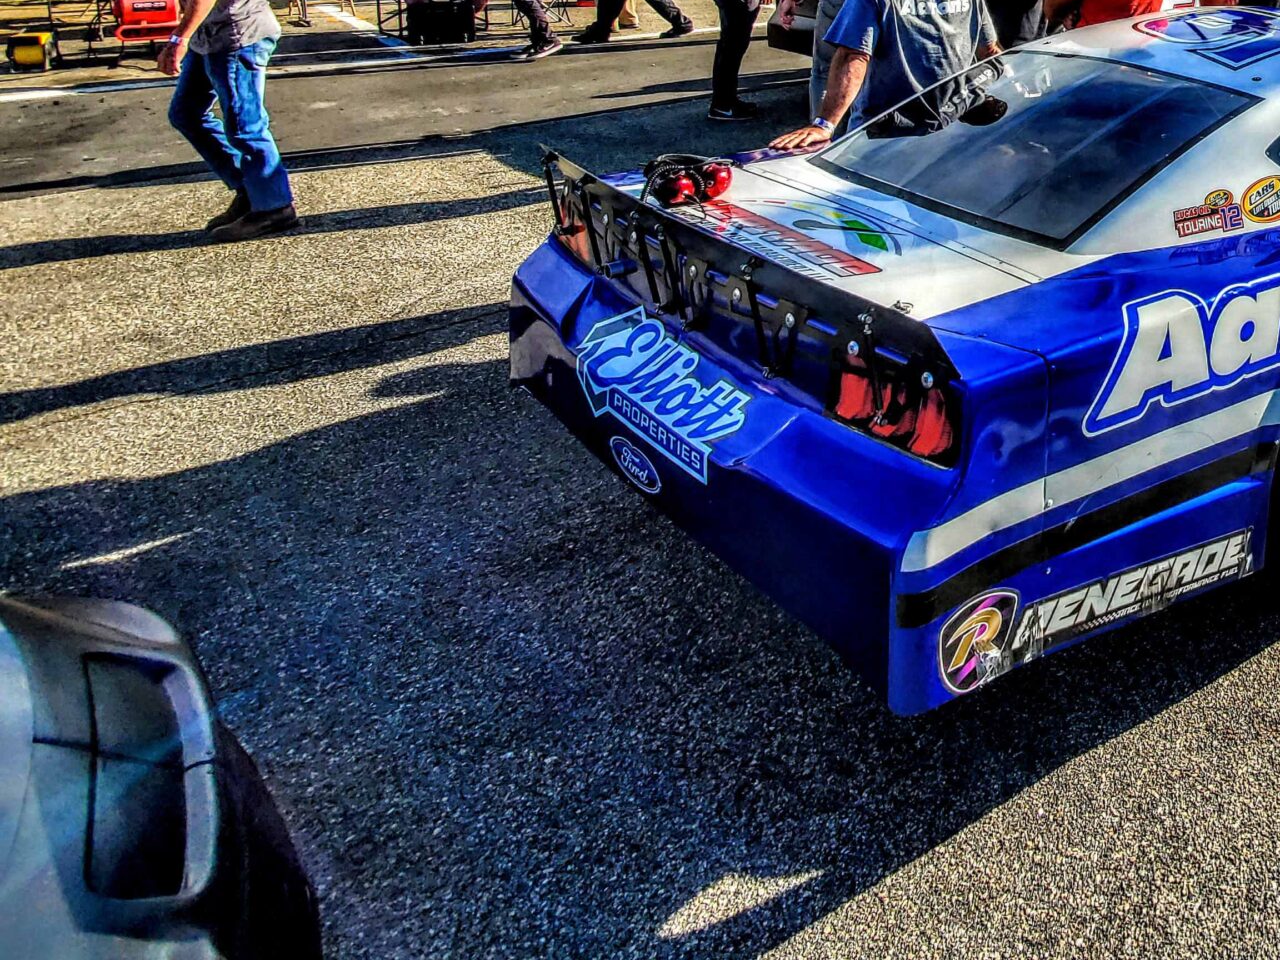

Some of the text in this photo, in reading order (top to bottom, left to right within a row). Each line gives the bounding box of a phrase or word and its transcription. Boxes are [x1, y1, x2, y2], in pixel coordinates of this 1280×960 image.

[1248, 179, 1275, 207] CARS
[1174, 206, 1212, 221] LUCAS OIL
[1176, 203, 1244, 235] TOURING 12
[587, 322, 744, 438] Elliott
[613, 392, 701, 470] PROPERTIES
[620, 446, 649, 484] Ford
[1221, 566, 1239, 583] FUEL
